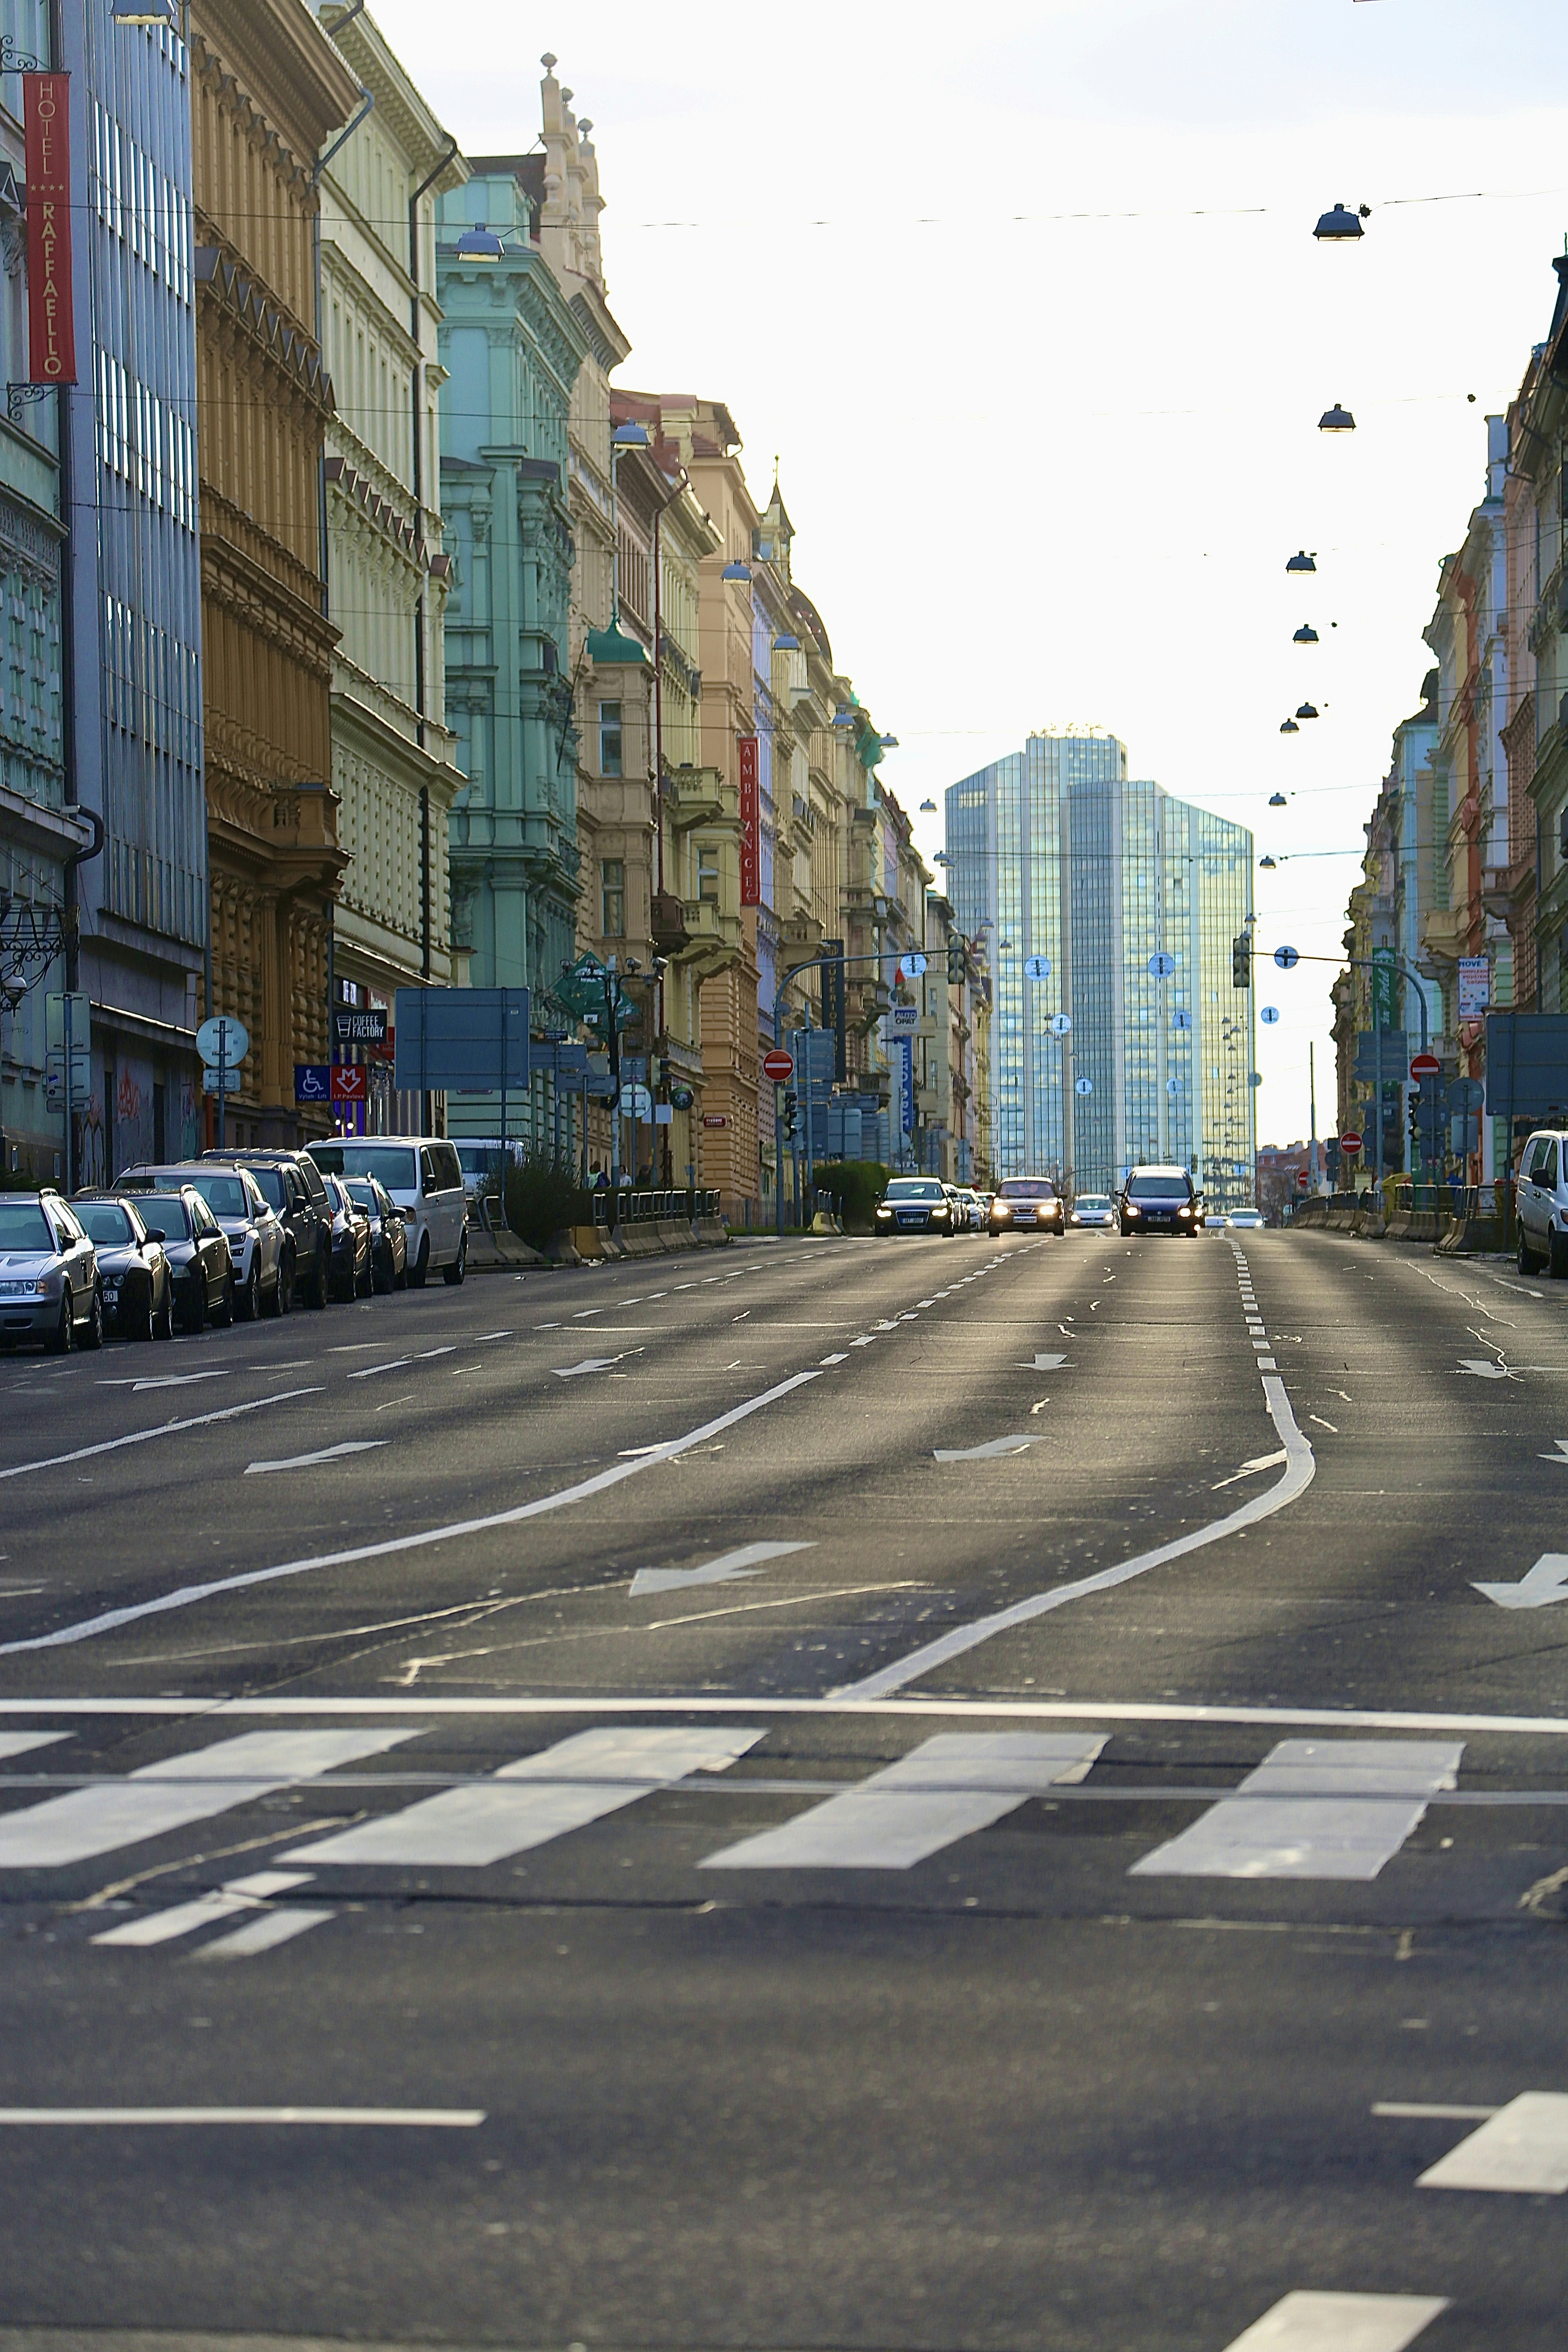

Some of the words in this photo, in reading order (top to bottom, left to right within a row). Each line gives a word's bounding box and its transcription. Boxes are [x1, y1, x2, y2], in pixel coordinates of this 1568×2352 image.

[38, 81, 56, 174] HOTEL
[41, 202, 62, 375] RAFFAELLO
[742, 746, 753, 887] AMBIANCE
[352, 1015, 379, 1027] COFFEE
[352, 1026, 383, 1037] FACTORY
